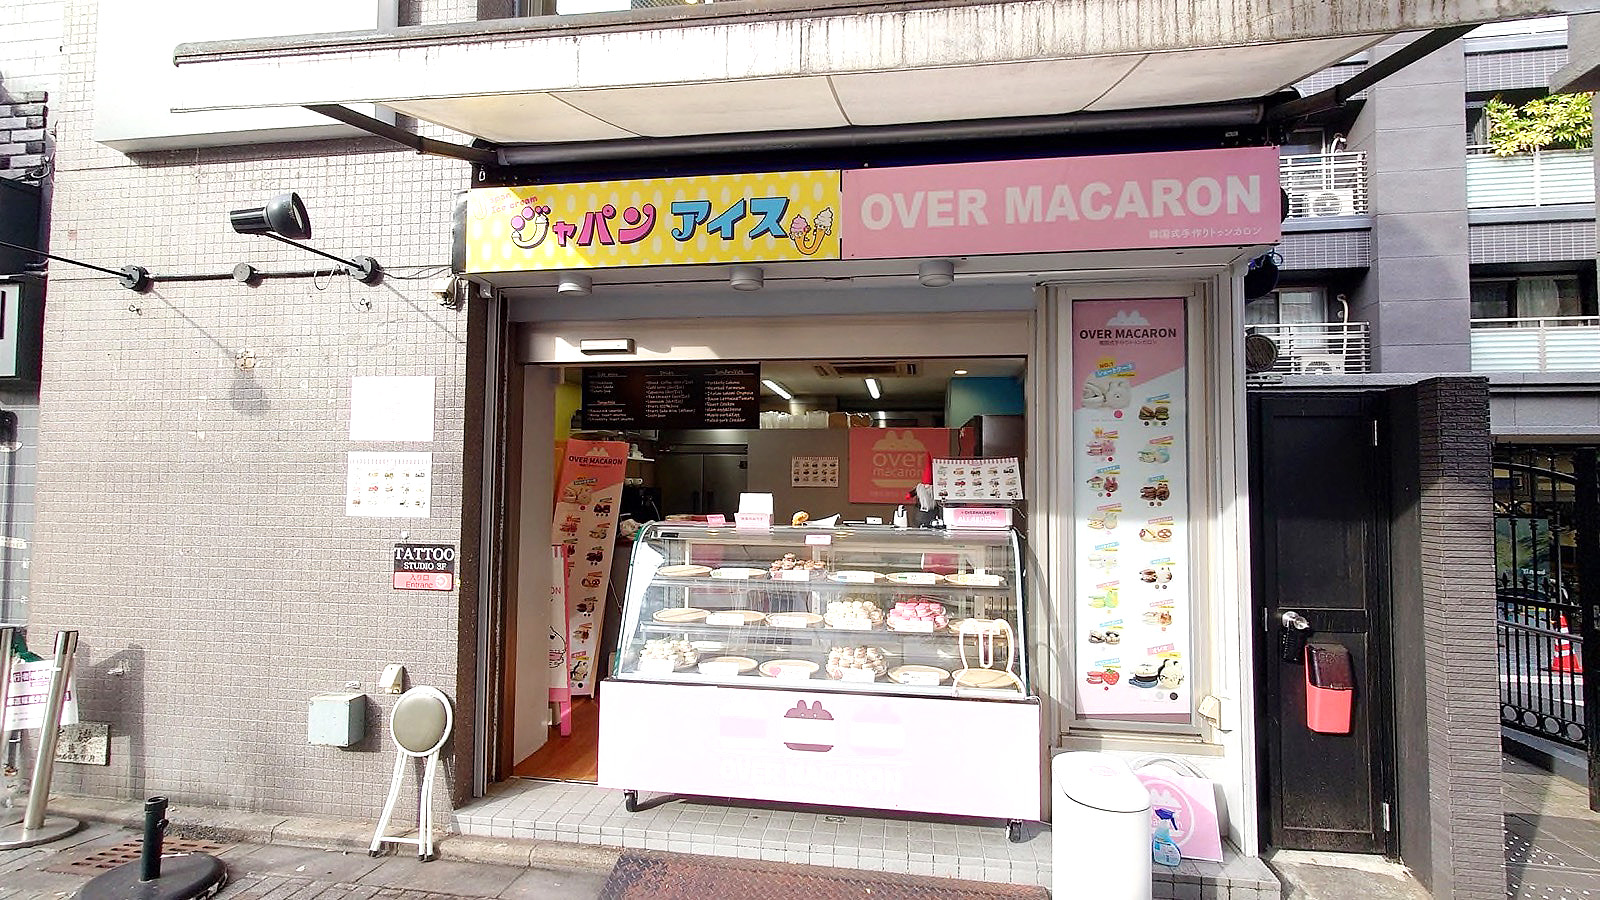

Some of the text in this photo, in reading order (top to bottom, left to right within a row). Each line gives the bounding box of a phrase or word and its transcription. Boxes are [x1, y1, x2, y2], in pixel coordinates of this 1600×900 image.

[860, 175, 1261, 231] OVER MACARON
[511, 196, 790, 249] ジャパン アイス
[1079, 328, 1177, 339] OVER MACARON
[568, 455, 589, 464] OVER
[589, 457, 623, 465] MACARON
[872, 453, 926, 468] over
[394, 547, 455, 561] TATTOO
[403, 562, 434, 570] STUDIO
